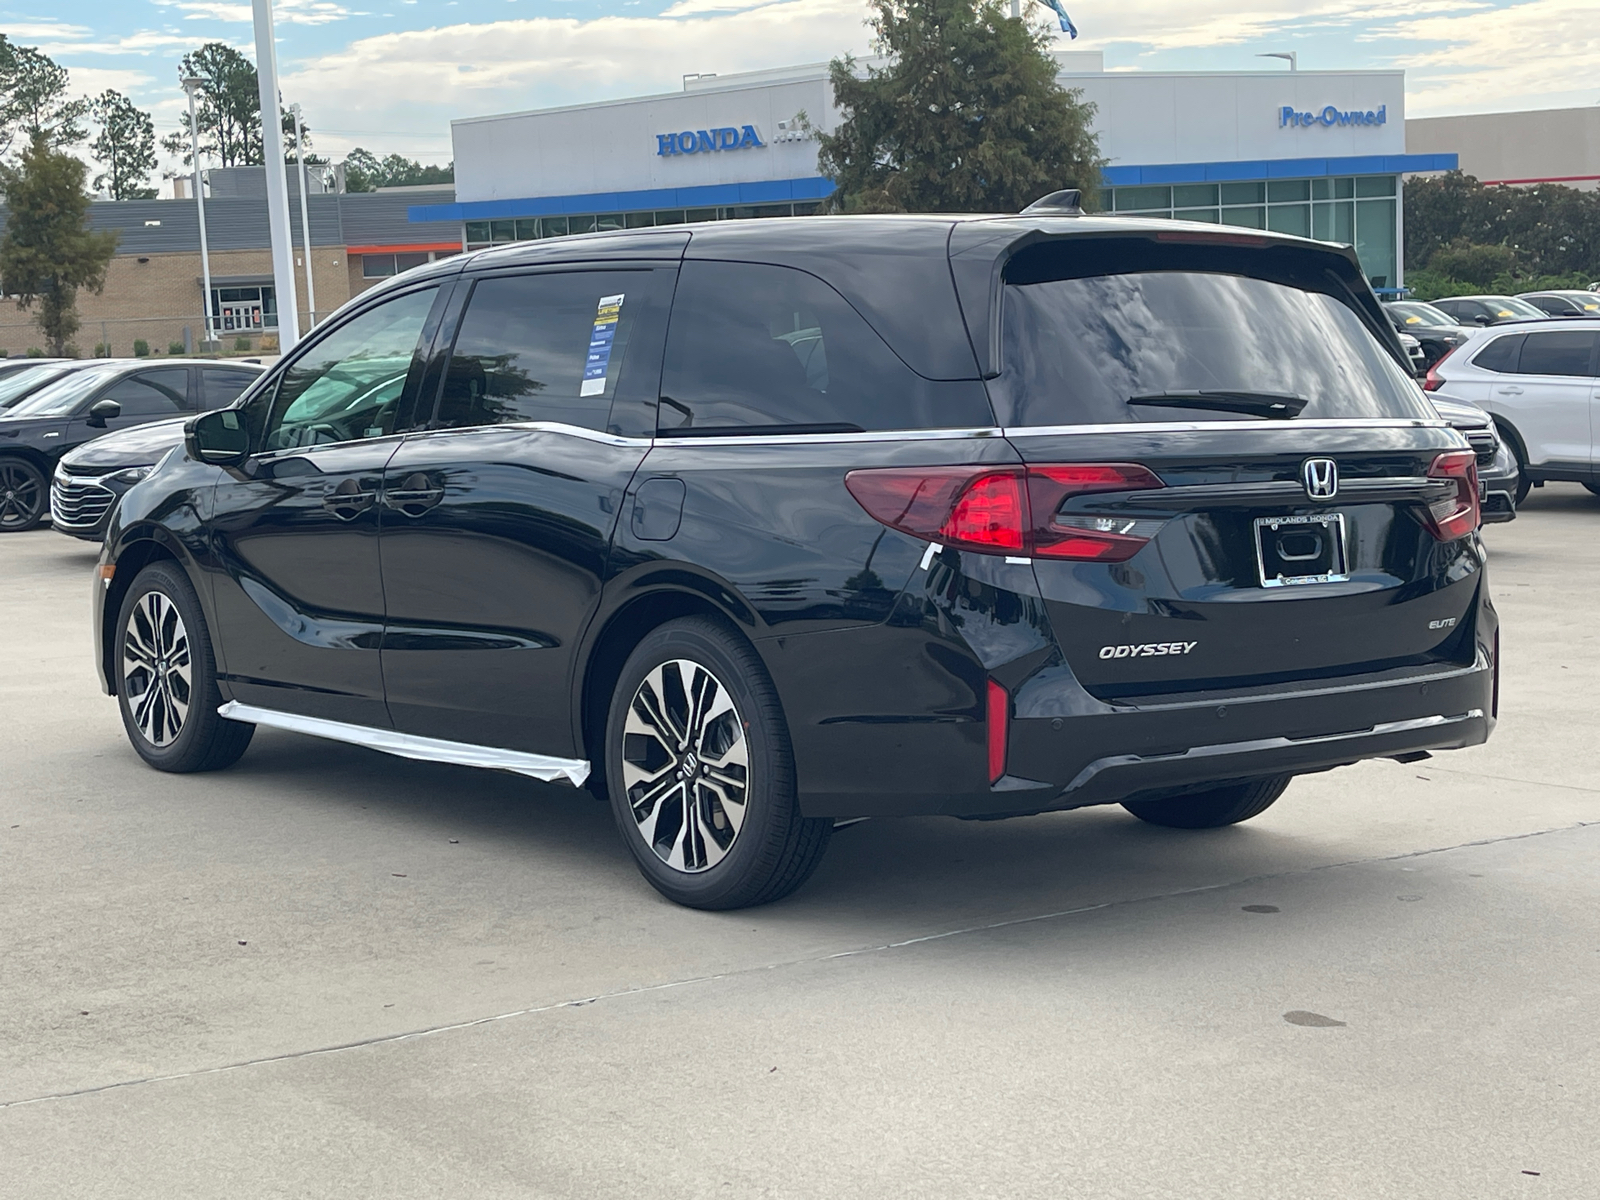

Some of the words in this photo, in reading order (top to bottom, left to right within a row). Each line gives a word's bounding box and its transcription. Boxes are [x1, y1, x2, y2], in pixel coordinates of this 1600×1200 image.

[1280, 105, 1386, 127] Pre-Owned
[656, 125, 764, 156] HONDA
[1265, 516, 1307, 525] MIDLANDS
[1310, 514, 1338, 522] HONDA
[1429, 617, 1456, 629] ELITE
[1099, 641, 1198, 659] ODYSSEY
